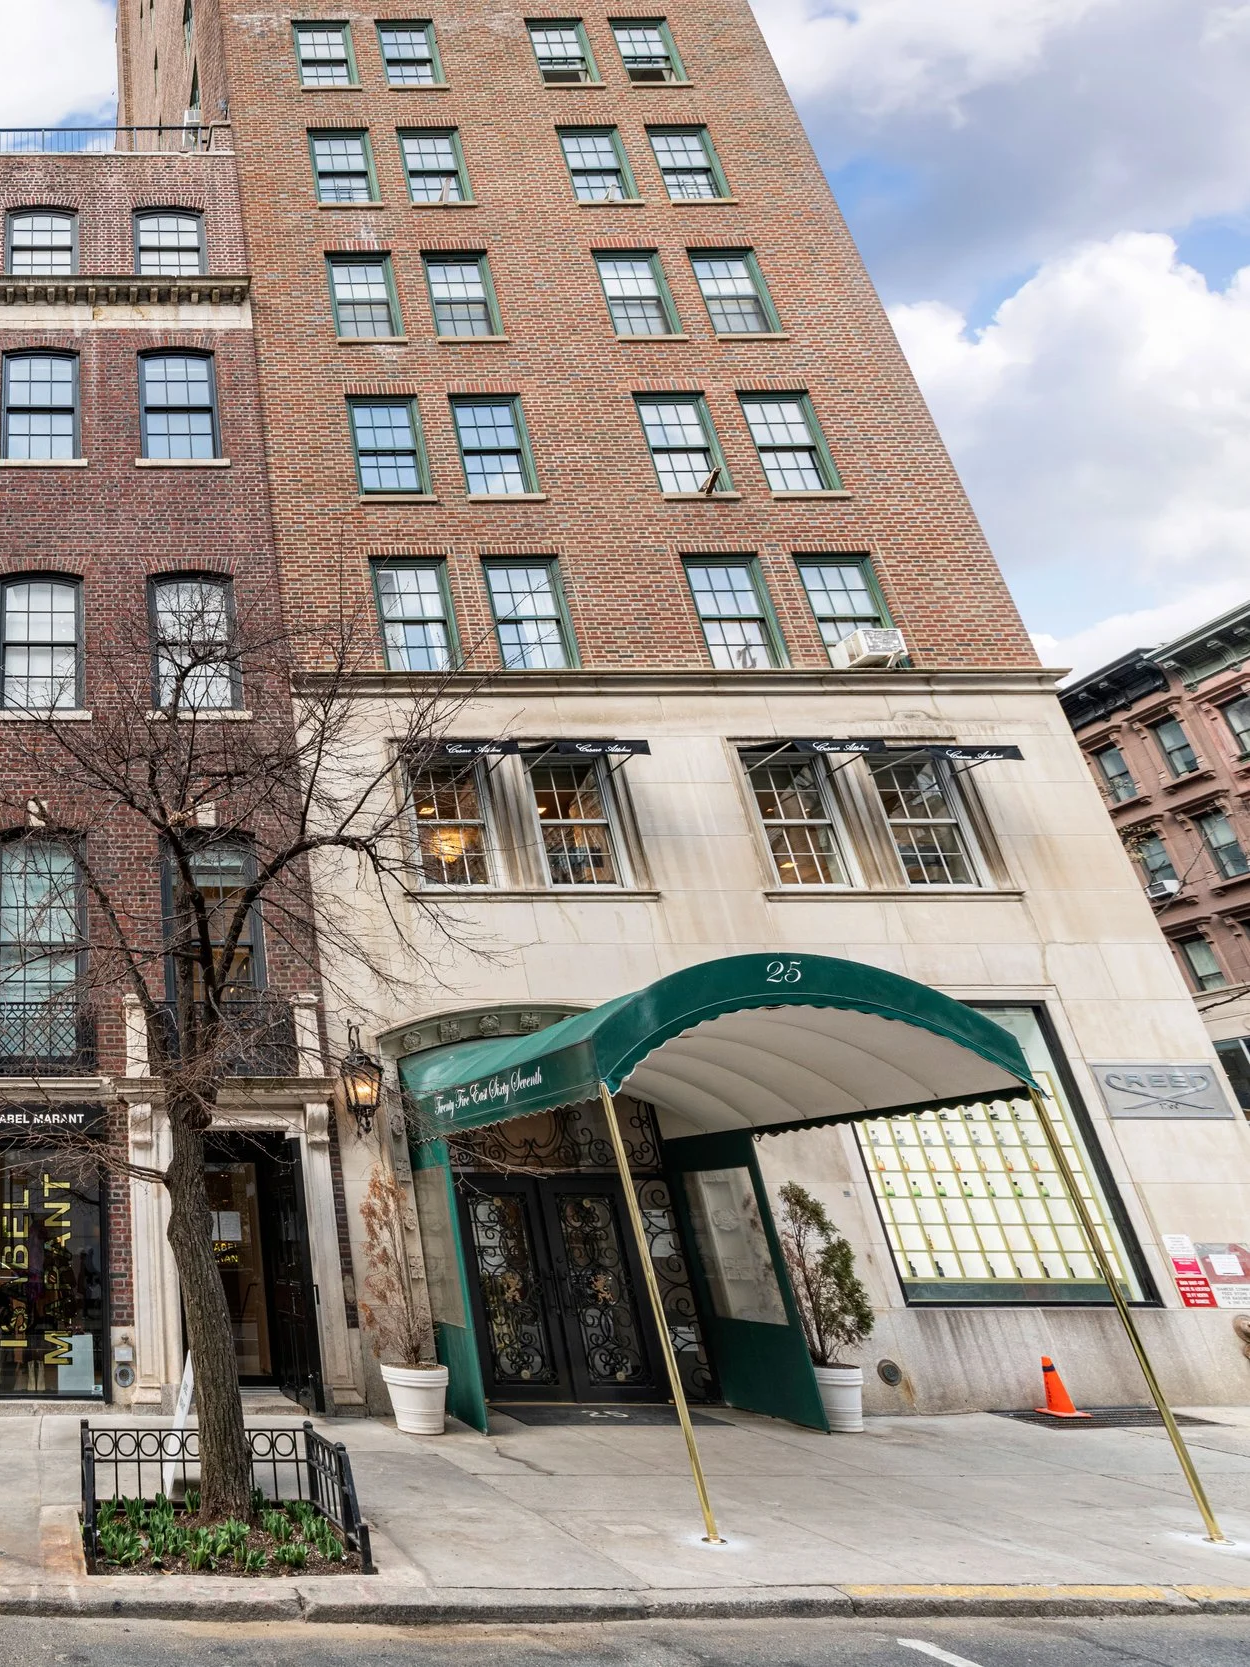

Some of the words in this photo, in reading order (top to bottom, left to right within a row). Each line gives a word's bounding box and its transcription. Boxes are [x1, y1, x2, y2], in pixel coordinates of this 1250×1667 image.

[766, 960, 802, 983] 25
[469, 1083, 488, 1105] East
[488, 1075, 510, 1104] Sixty
[510, 1066, 542, 1096] Seventh
[1104, 1072, 1211, 1092] CREED
[34, 1113, 85, 1125] MARANT
[580, 1410, 629, 1418] 25
